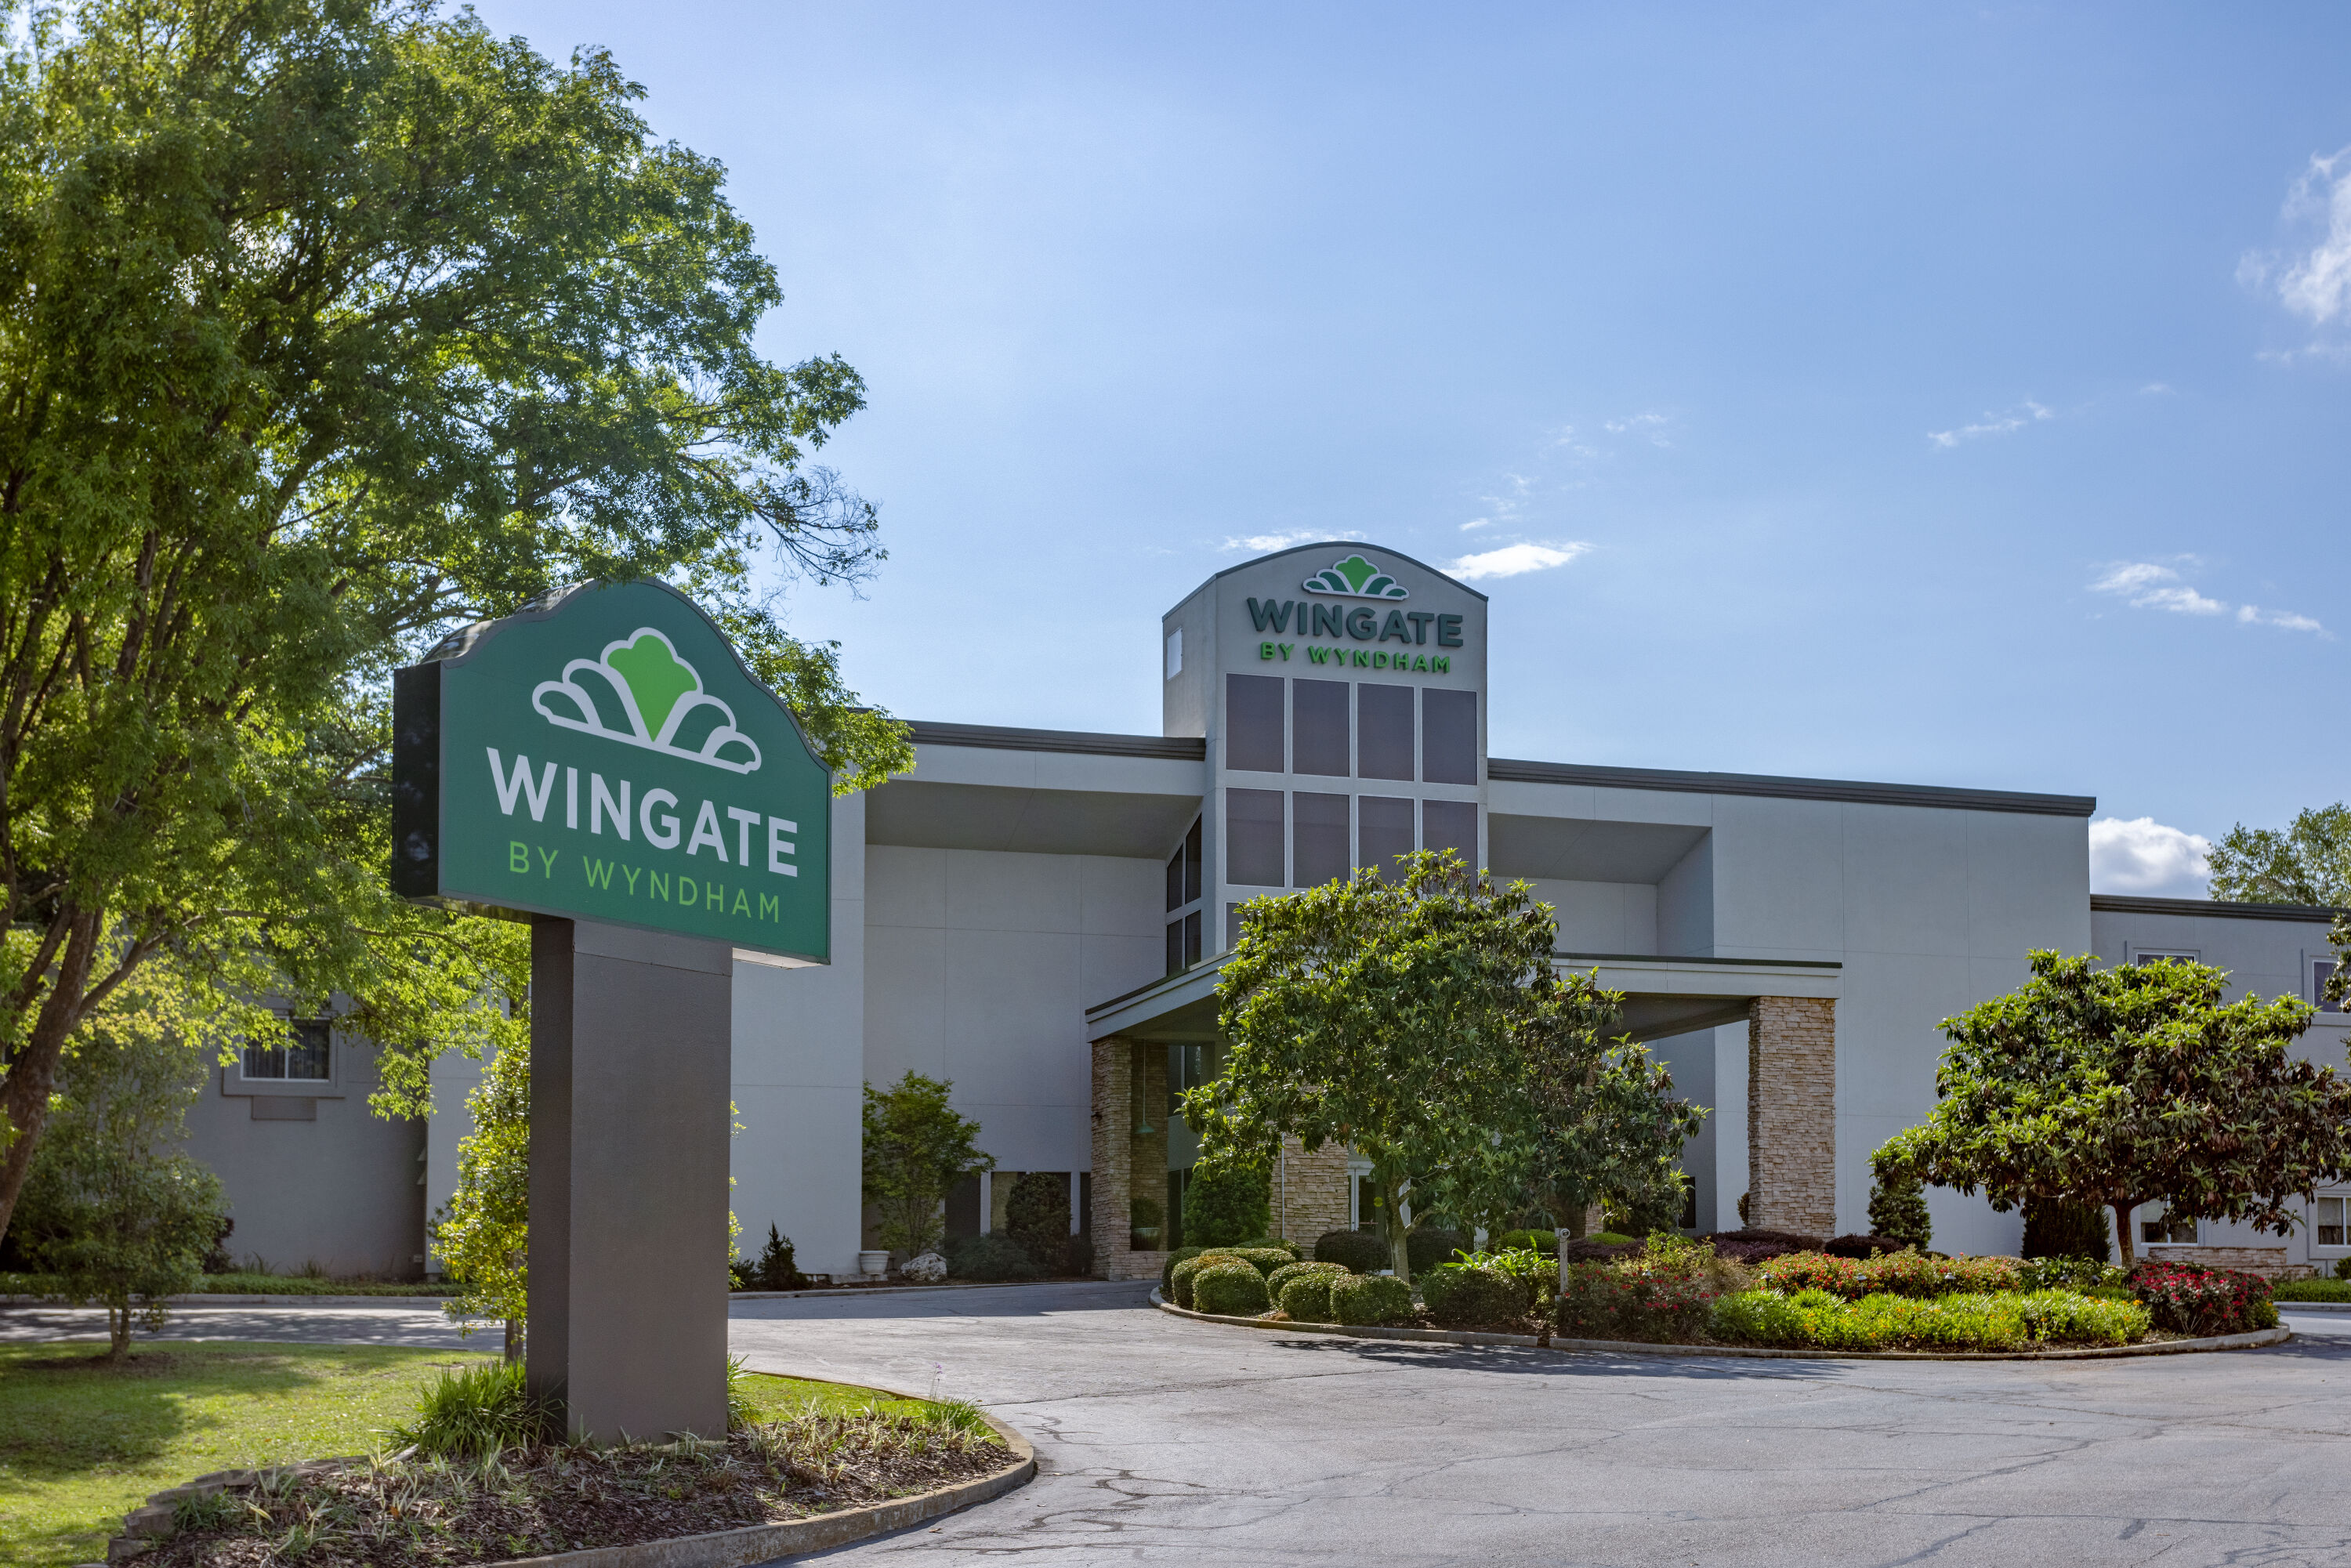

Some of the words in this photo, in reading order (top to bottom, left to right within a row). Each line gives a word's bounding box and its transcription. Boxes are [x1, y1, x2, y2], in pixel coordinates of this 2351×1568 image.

[1247, 597, 1464, 647] WINGATE
[1260, 642, 1295, 661] BY
[1308, 646, 1451, 674] WYNDHAM
[486, 747, 798, 878] WINGATE
[509, 841, 559, 878] BY
[582, 856, 780, 923] WYNDHAM
